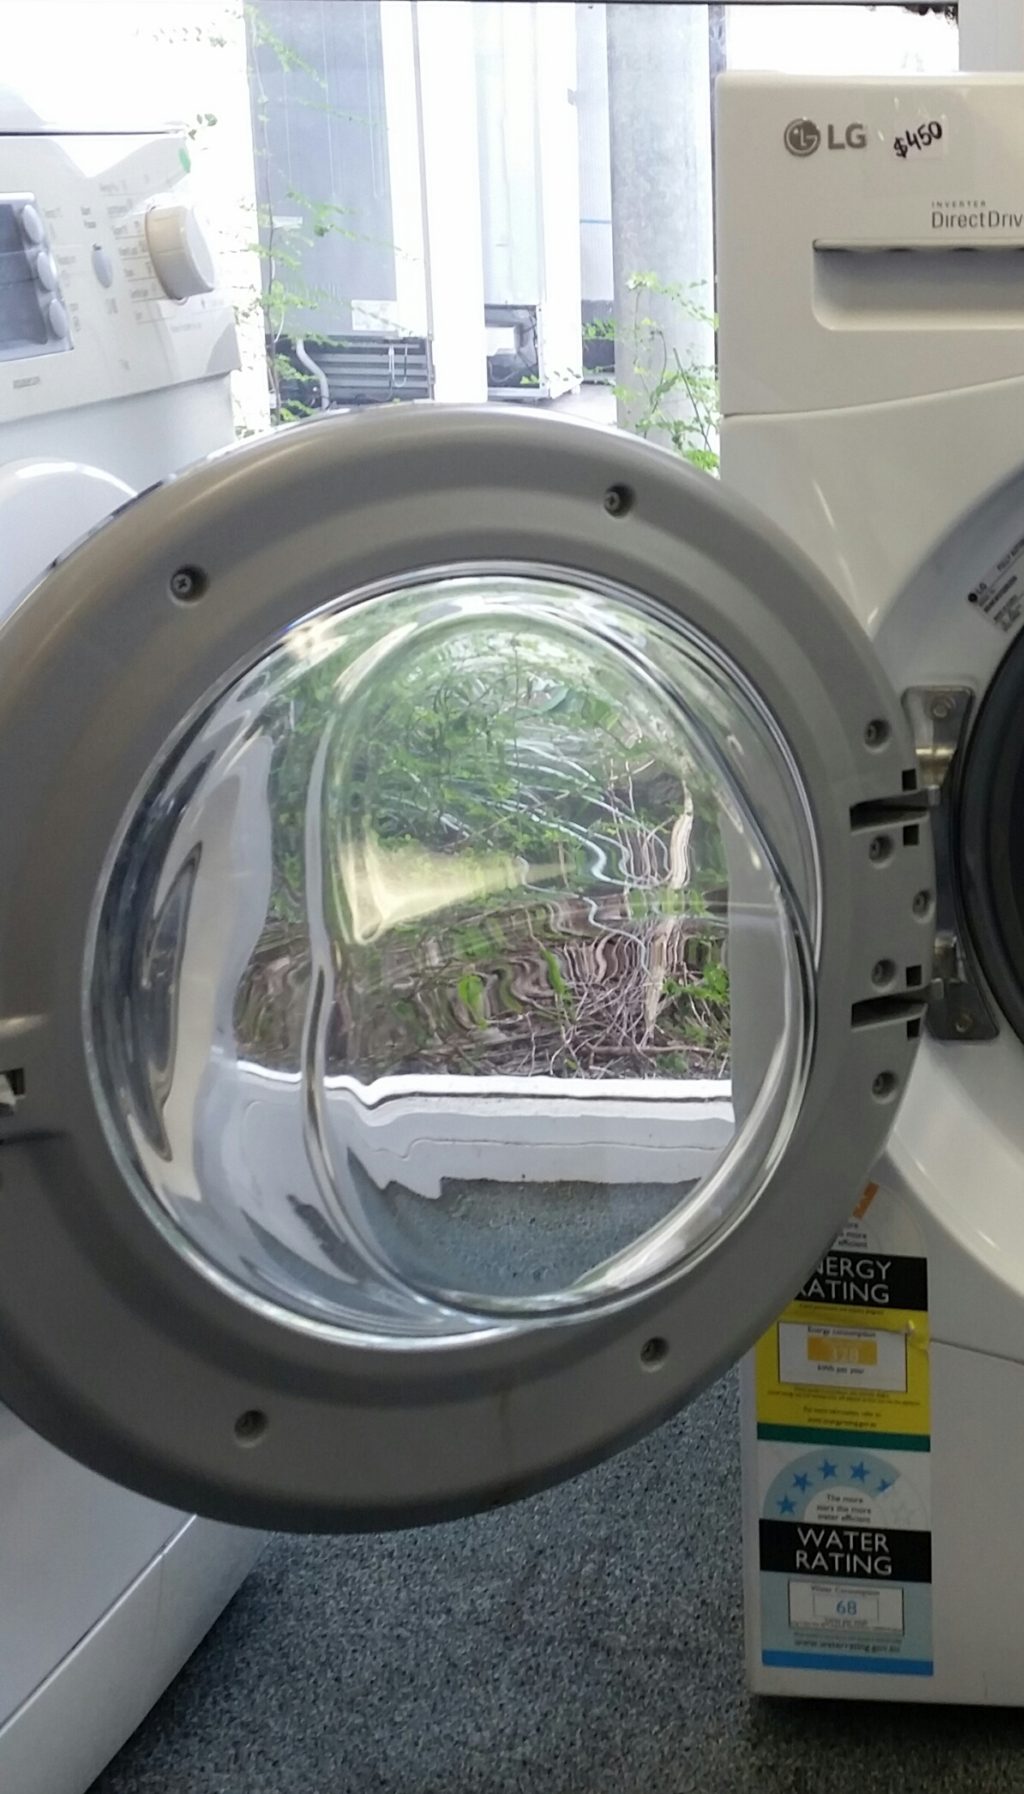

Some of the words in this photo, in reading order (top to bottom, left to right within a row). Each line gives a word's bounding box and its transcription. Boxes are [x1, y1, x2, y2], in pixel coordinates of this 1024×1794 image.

[827, 123, 867, 150] LG
[893, 121, 943, 158] $450
[931, 200, 986, 208] INVERTER
[816, 1256, 892, 1280] NERGY
[801, 1278, 890, 1304] ATING
[827, 1494, 841, 1502] The
[797, 1527, 890, 1553] WATER
[796, 1549, 892, 1576] RATING
